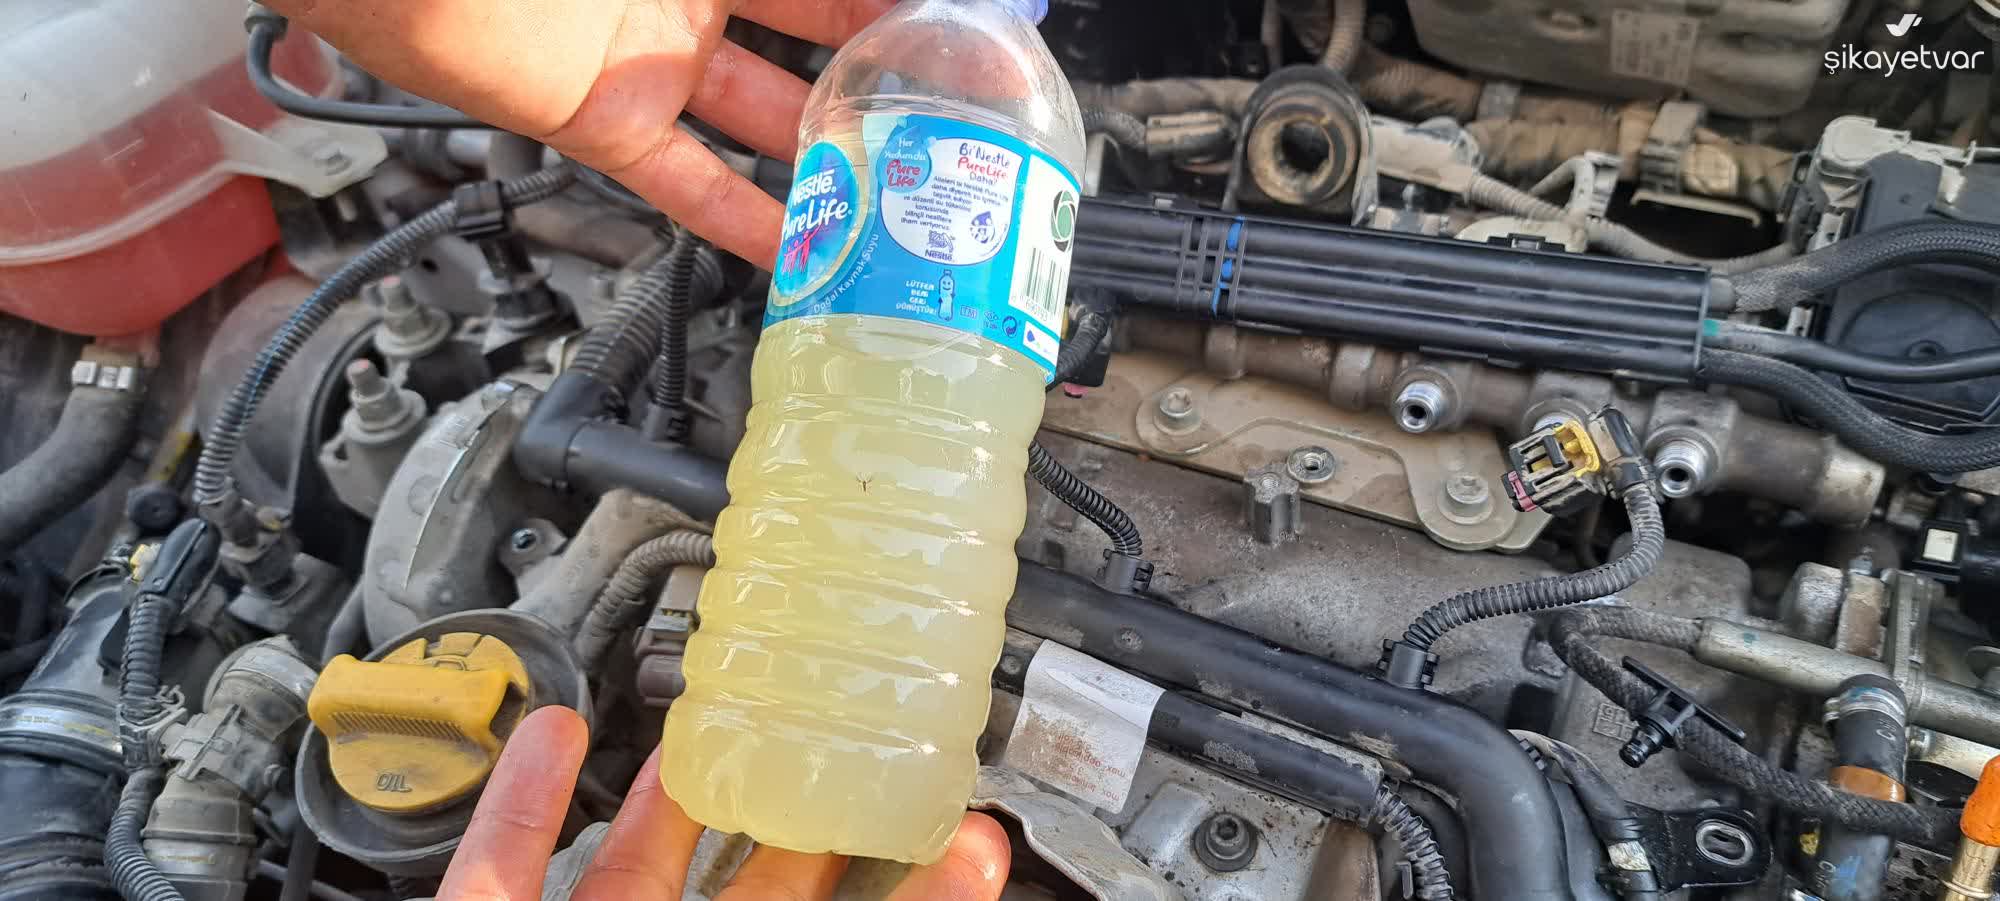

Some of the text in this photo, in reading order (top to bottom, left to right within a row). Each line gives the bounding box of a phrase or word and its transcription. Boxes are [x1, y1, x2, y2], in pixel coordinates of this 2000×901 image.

[886, 158, 921, 176] Pure
[861, 233, 880, 262] Suyu
[375, 771, 413, 793] OIL
